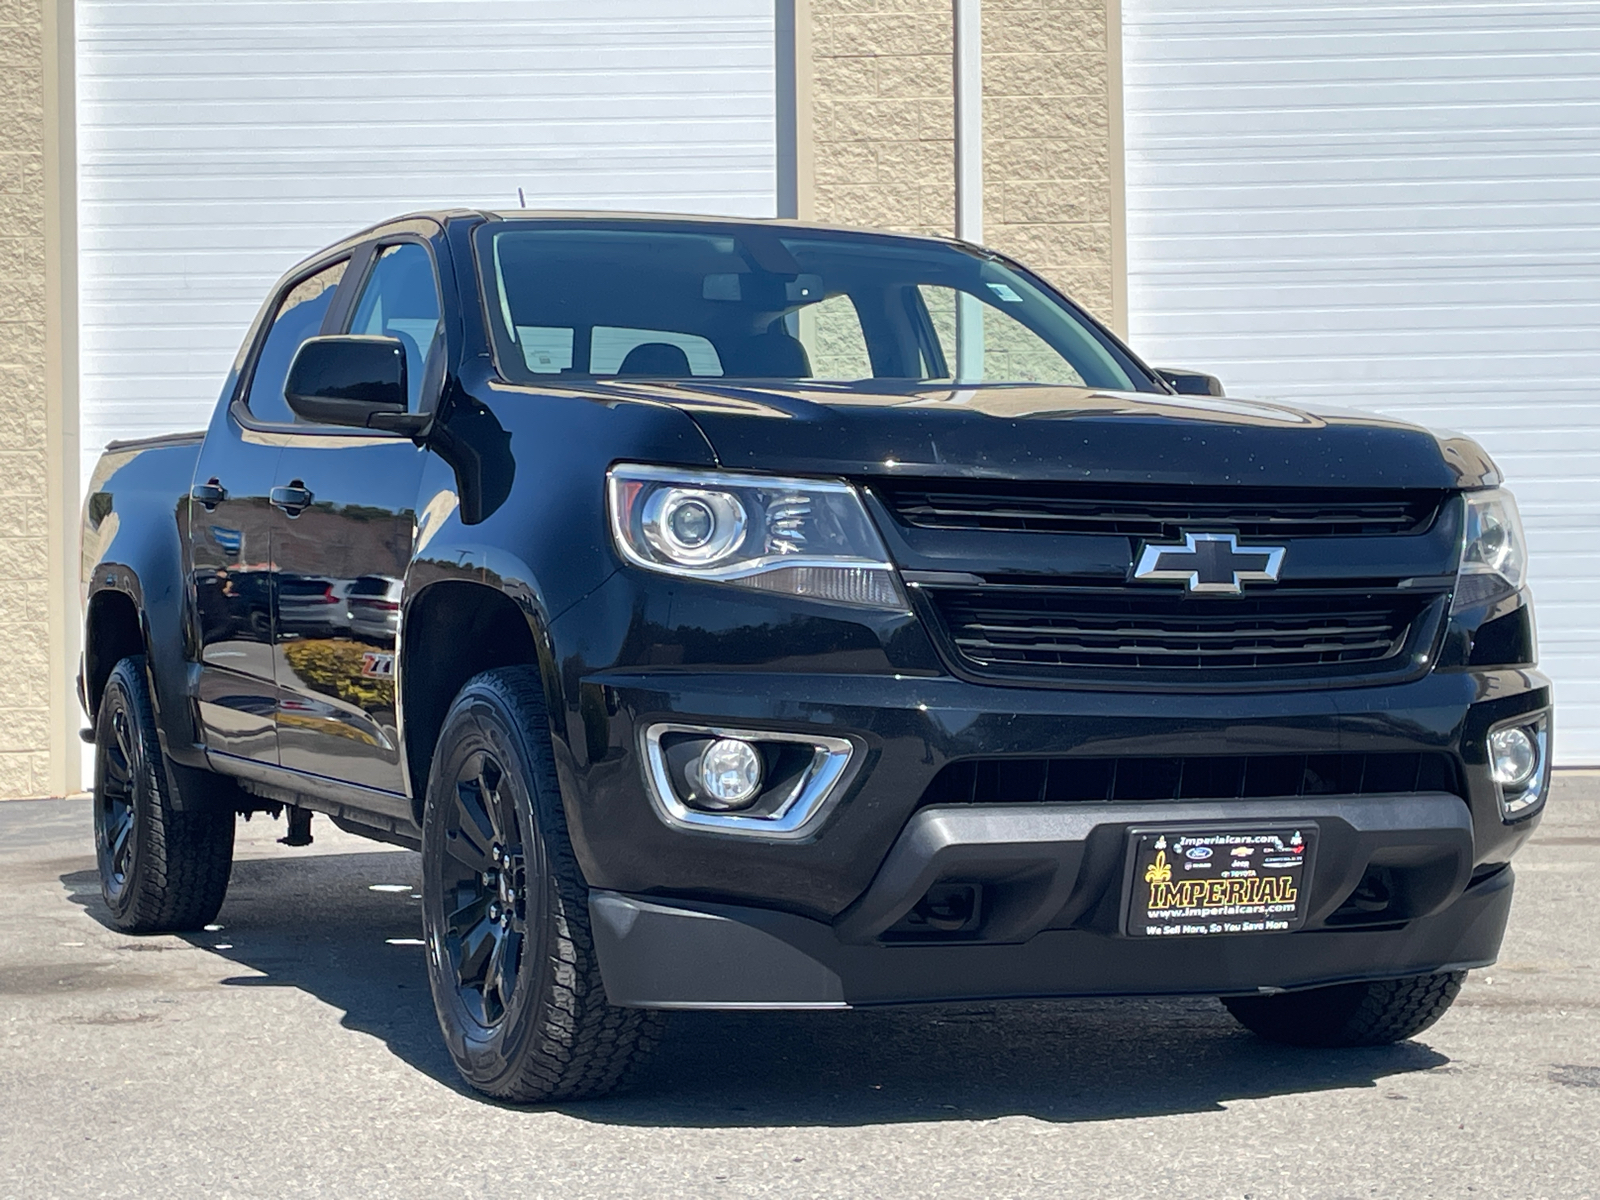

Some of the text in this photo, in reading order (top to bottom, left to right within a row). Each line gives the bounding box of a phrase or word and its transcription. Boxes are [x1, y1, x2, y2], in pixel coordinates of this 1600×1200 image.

[1149, 877, 1297, 908] IMPERIAL
[1147, 904, 1295, 918] www.imperialcars.com
[1146, 926, 1162, 935] We
[1163, 925, 1181, 934] Sell
[1209, 923, 1222, 933] So
[1223, 922, 1241, 932] You
[1242, 921, 1264, 931] Save
[1265, 920, 1289, 930] More
